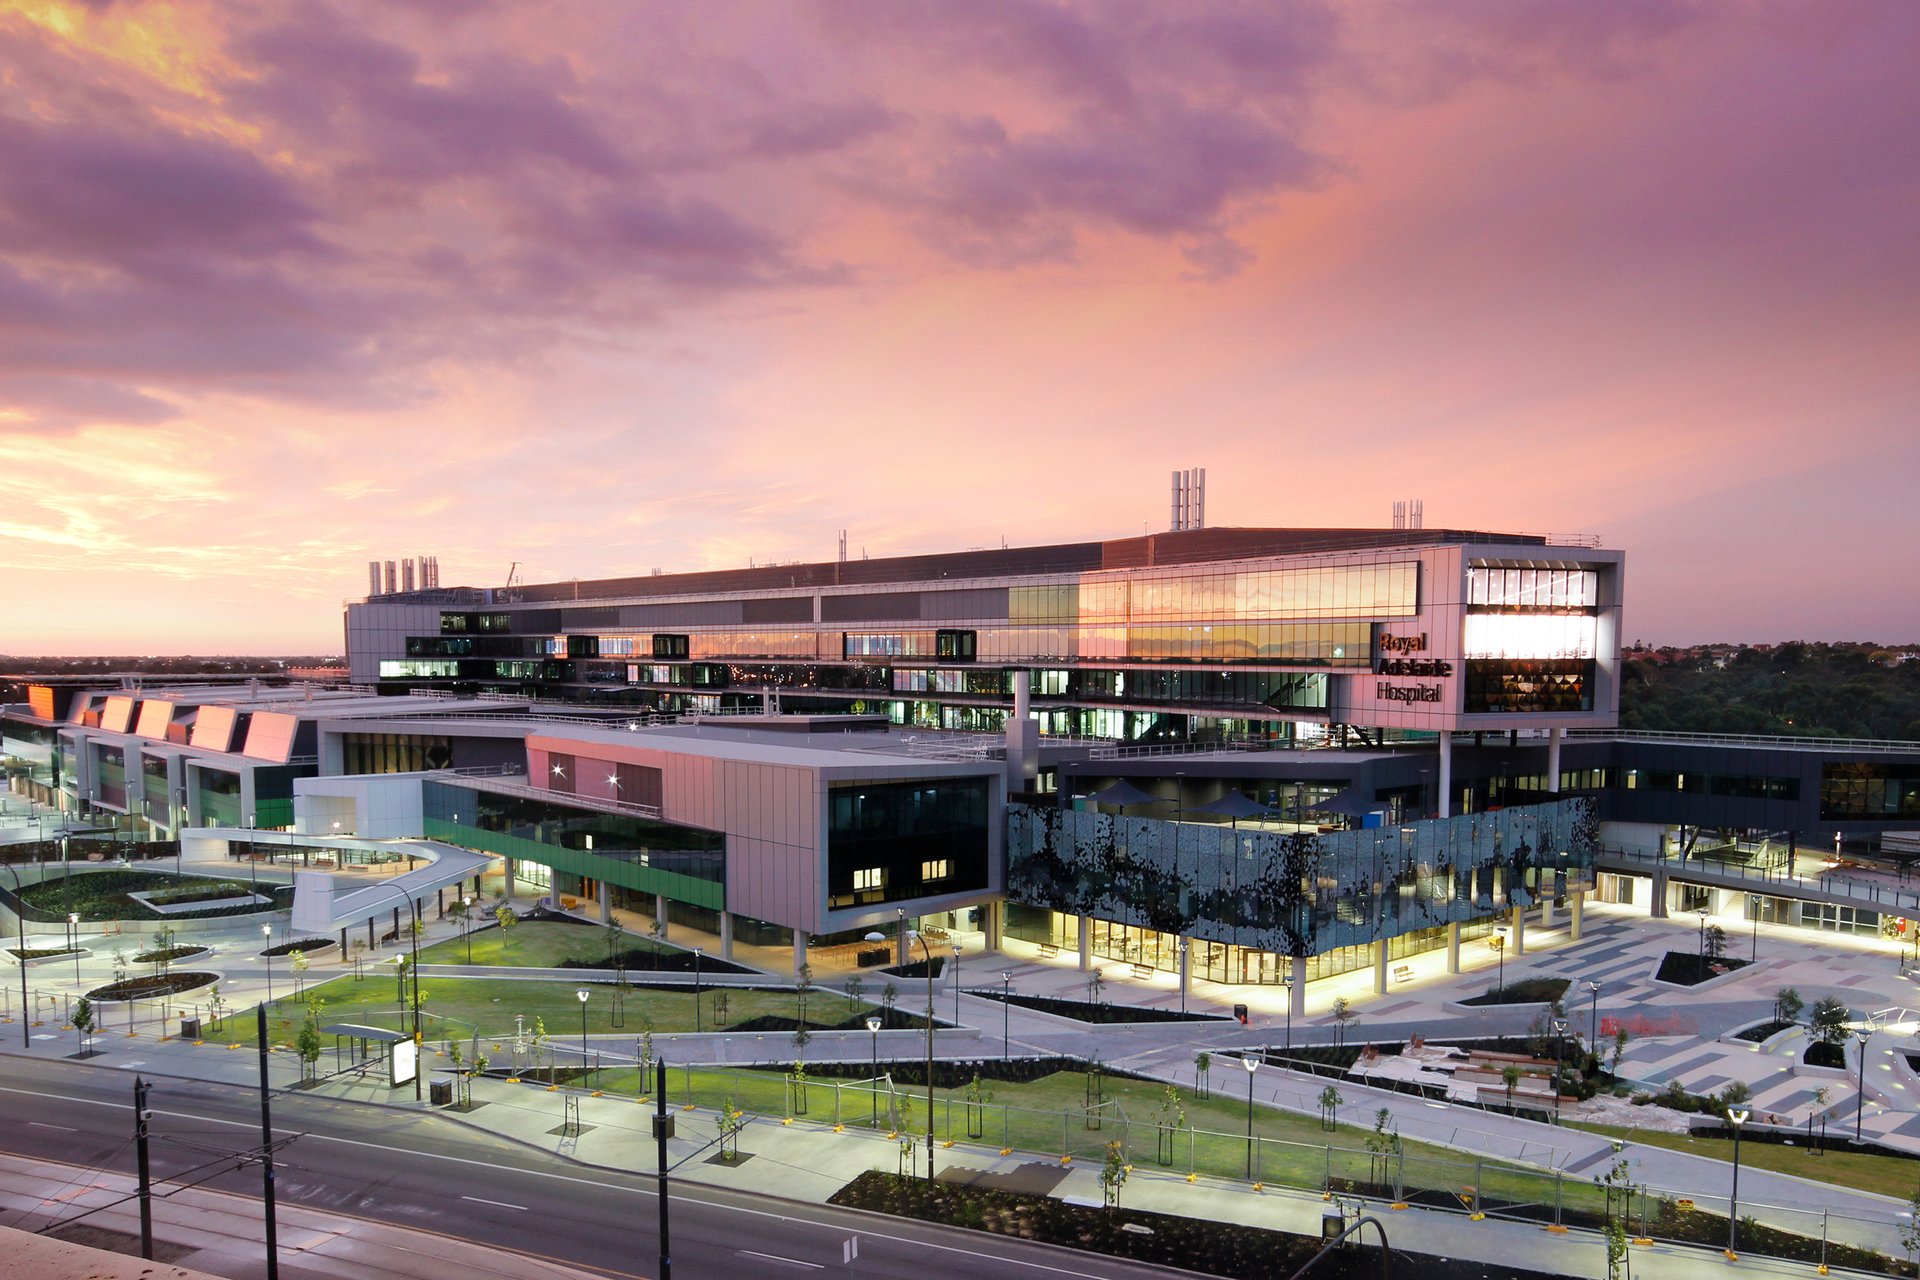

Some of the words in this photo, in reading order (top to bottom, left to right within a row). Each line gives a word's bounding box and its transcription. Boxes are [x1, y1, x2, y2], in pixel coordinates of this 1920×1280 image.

[1379, 632, 1427, 656] Royal
[1378, 658, 1452, 678] Adelaide
[1377, 682, 1442, 706] Hospital
